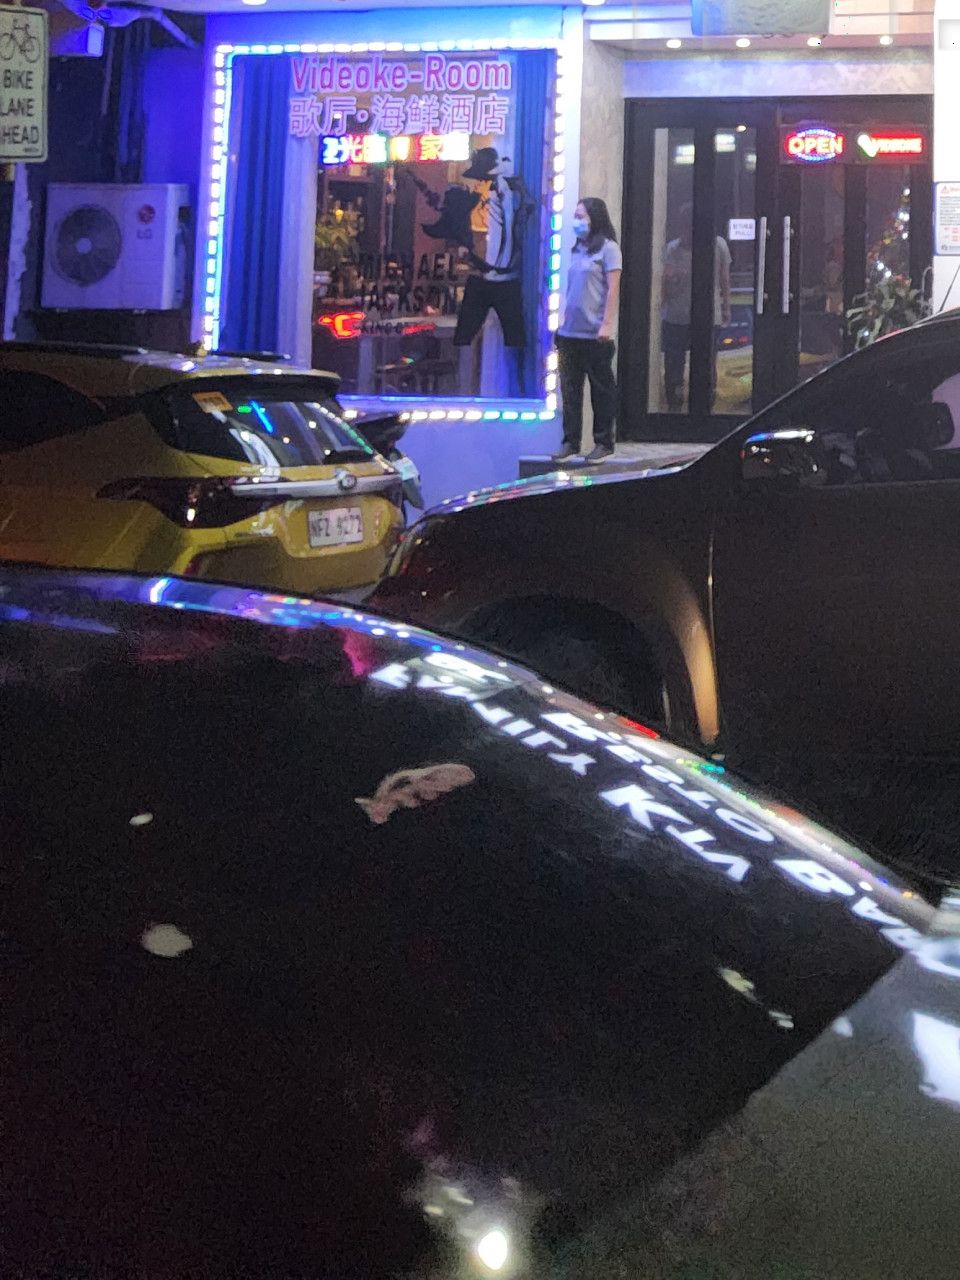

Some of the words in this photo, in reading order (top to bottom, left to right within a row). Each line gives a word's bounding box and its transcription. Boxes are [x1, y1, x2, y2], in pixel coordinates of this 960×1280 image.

[3, 70, 34, 89] BIKE
[291, 53, 512, 91] Videoke-Room
[0, 125, 39, 145] HEAD
[788, 135, 844, 155] OPEN
